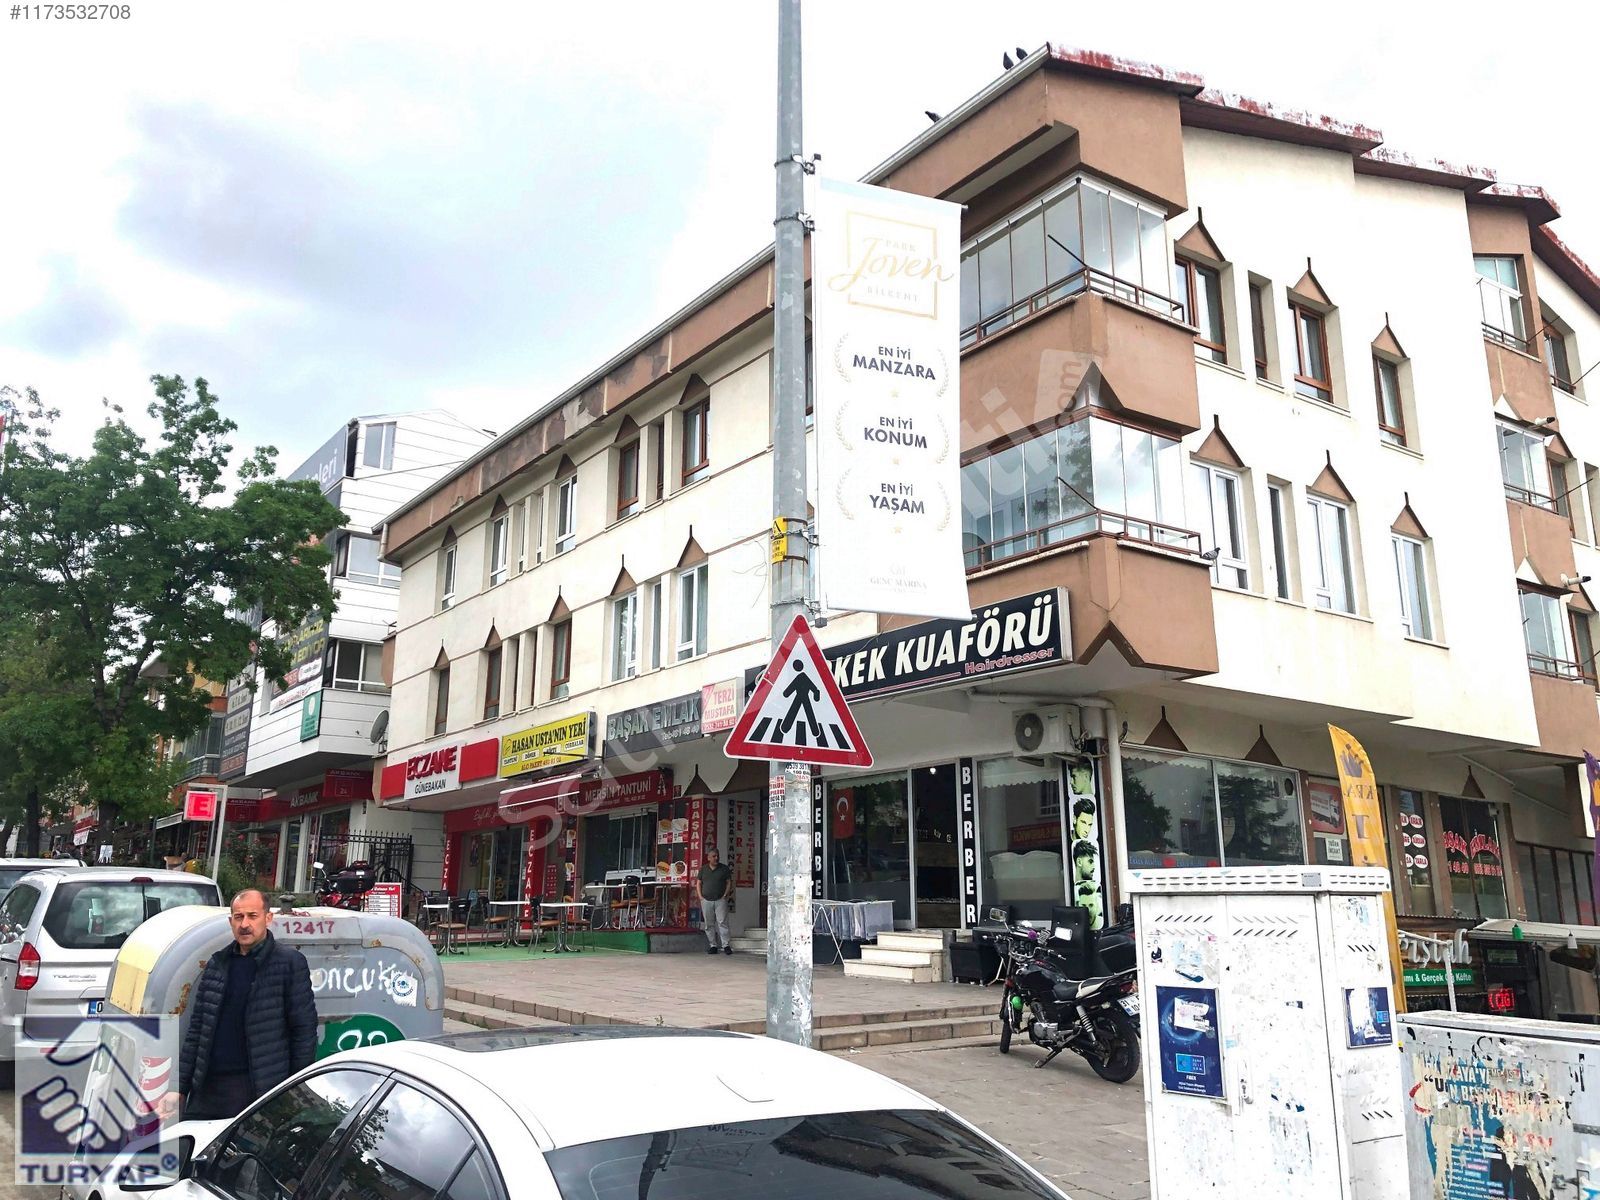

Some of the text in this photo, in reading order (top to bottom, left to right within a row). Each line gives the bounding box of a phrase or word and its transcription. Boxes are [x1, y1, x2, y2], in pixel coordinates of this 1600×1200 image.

[878, 345, 894, 357] EN
[852, 354, 936, 380] MANZARA
[879, 416, 895, 428] EN
[864, 427, 928, 449] KONUM
[881, 482, 896, 494] EN
[869, 494, 925, 515] YAŞAM
[827, 594, 1053, 688] KEK KUAFÖRÜ
[964, 646, 1055, 675] Hairdresser
[713, 684, 735, 706] TERZİ
[607, 697, 700, 742] BAŞAK EMLAK
[704, 705, 735, 720] MUSTAFA
[511, 717, 587, 753] HASAN USTA'NIN YERİ
[406, 746, 458, 781] ECZANE
[414, 779, 447, 794] GÜNEBAKAN
[585, 785, 615, 802] MERSİN
[615, 776, 651, 796] TANTUNİ
[193, 797, 209, 816] E
[290, 791, 319, 808] AKBANK
[814, 784, 822, 896] BERBE
[962, 766, 976, 924] BERBER
[442, 840, 451, 891] ECZA
[282, 920, 335, 934] 12417
[1421, 973, 1445, 984] Gerçek
